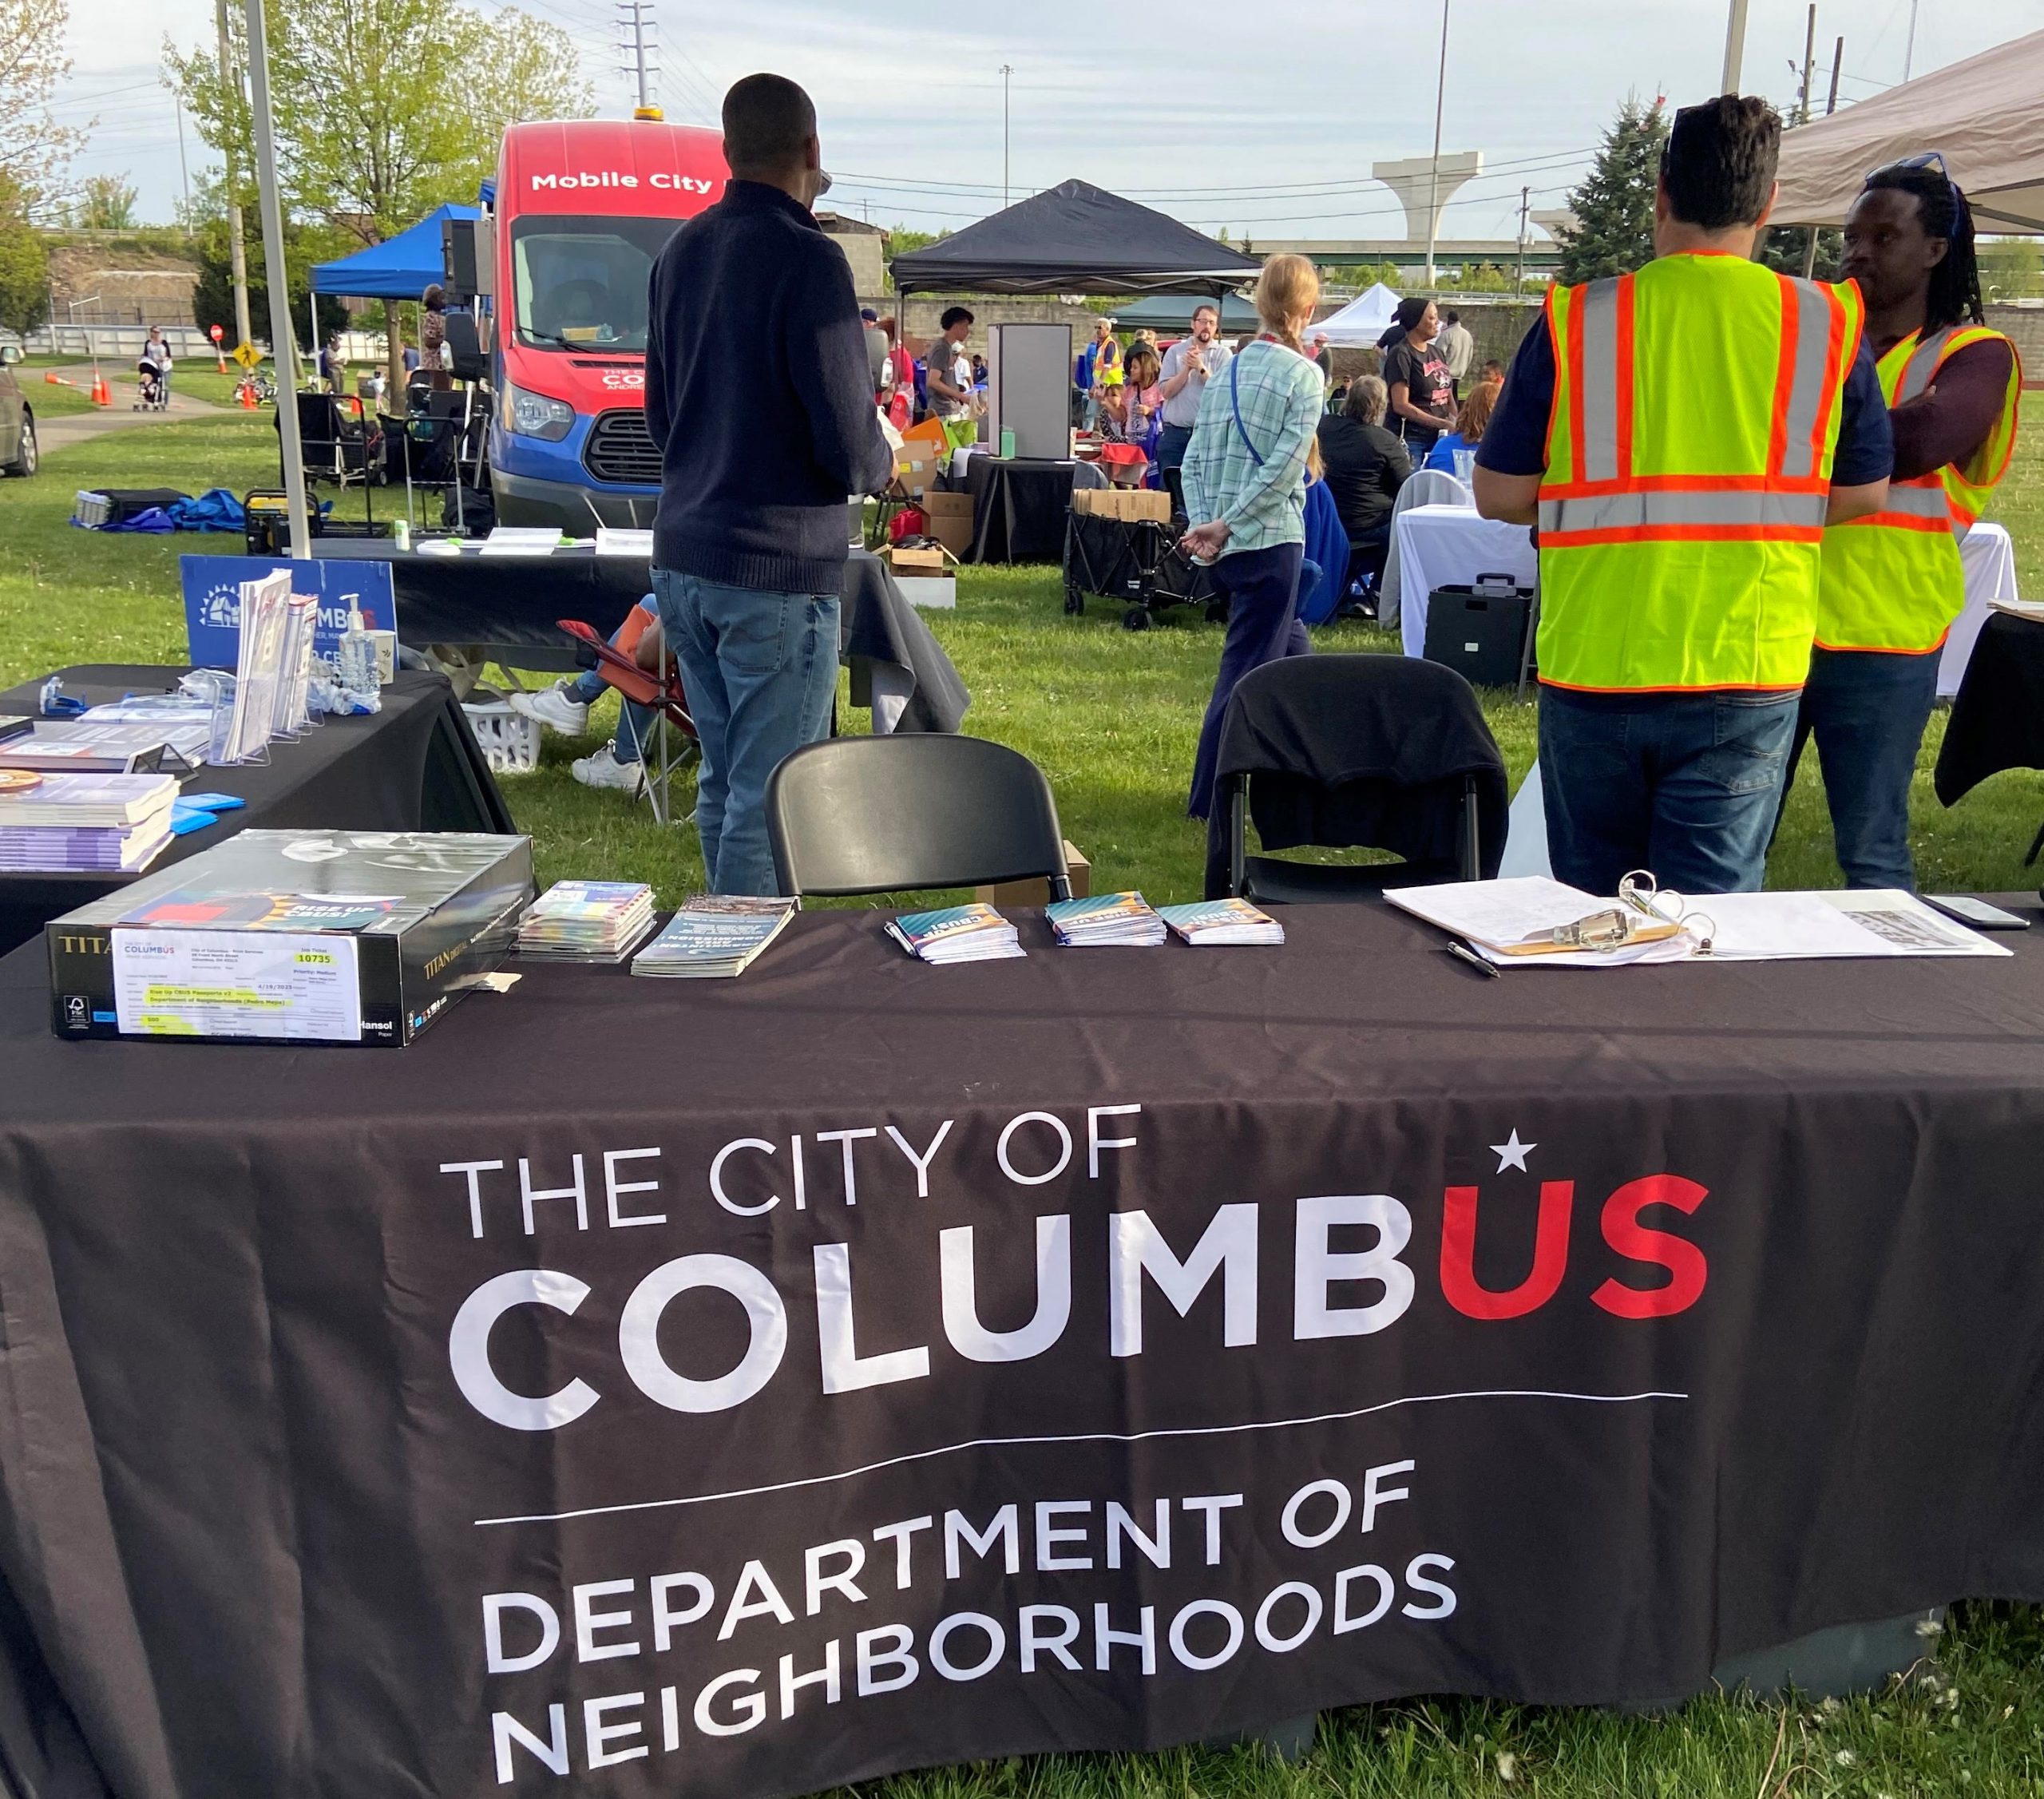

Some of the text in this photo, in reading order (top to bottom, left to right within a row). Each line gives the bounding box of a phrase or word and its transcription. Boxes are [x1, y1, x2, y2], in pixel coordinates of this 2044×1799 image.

[532, 172, 713, 194] Mobile City
[930, 915, 983, 930] CBUS!
[125, 945, 175, 954] COLUMBUS
[299, 954, 331, 963] 10735
[423, 951, 450, 980] TITAN
[440, 1103, 1142, 1239] THE CITY OF
[449, 1172, 1709, 1432] COLUMBUS
[481, 1459, 1415, 1674] DEPARTMENT OF
[491, 1553, 1457, 1785] NEIGHBORHOODS
